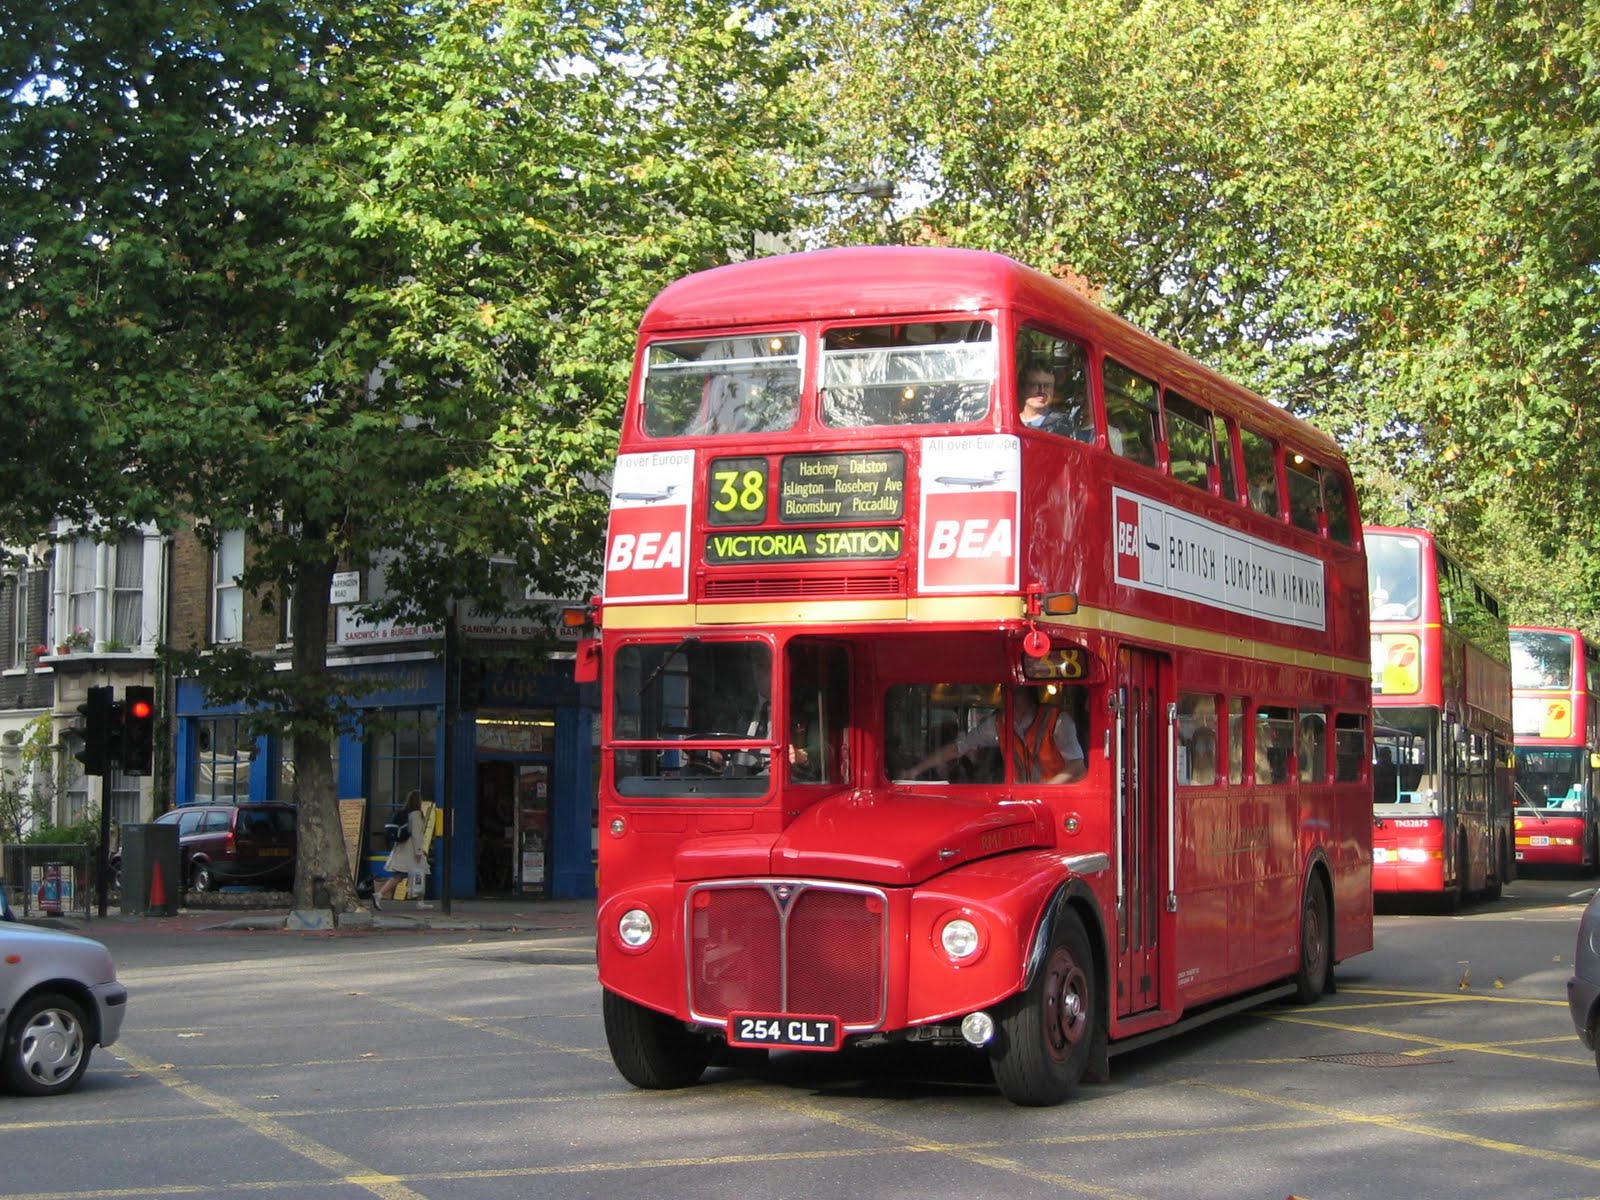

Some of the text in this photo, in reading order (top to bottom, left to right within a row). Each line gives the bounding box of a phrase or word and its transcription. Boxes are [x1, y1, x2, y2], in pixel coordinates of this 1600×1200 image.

[928, 438, 944, 451] All
[947, 440, 972, 450] over
[625, 456, 649, 468] over
[652, 453, 689, 467] Europe
[799, 459, 887, 478] Hackney Dalston
[714, 470, 764, 512] 38
[783, 477, 903, 497] Islington Rosebery Ave
[785, 496, 898, 516] Bloomsbury Piccadilly
[714, 531, 899, 557] VICTORIA STATION
[927, 518, 1012, 560] BEA
[1118, 521, 1139, 557] BEA
[607, 531, 682, 571] BEA
[1169, 536, 1321, 608] BRITISH EUROPEAN AIRWAYS
[345, 630, 379, 641] SANDWICH
[390, 626, 419, 637] BURGER
[462, 625, 507, 634] SANDWICH
[521, 626, 557, 636] BURGR
[560, 628, 579, 636] BAR
[740, 1018, 829, 1042] 254 CLT
